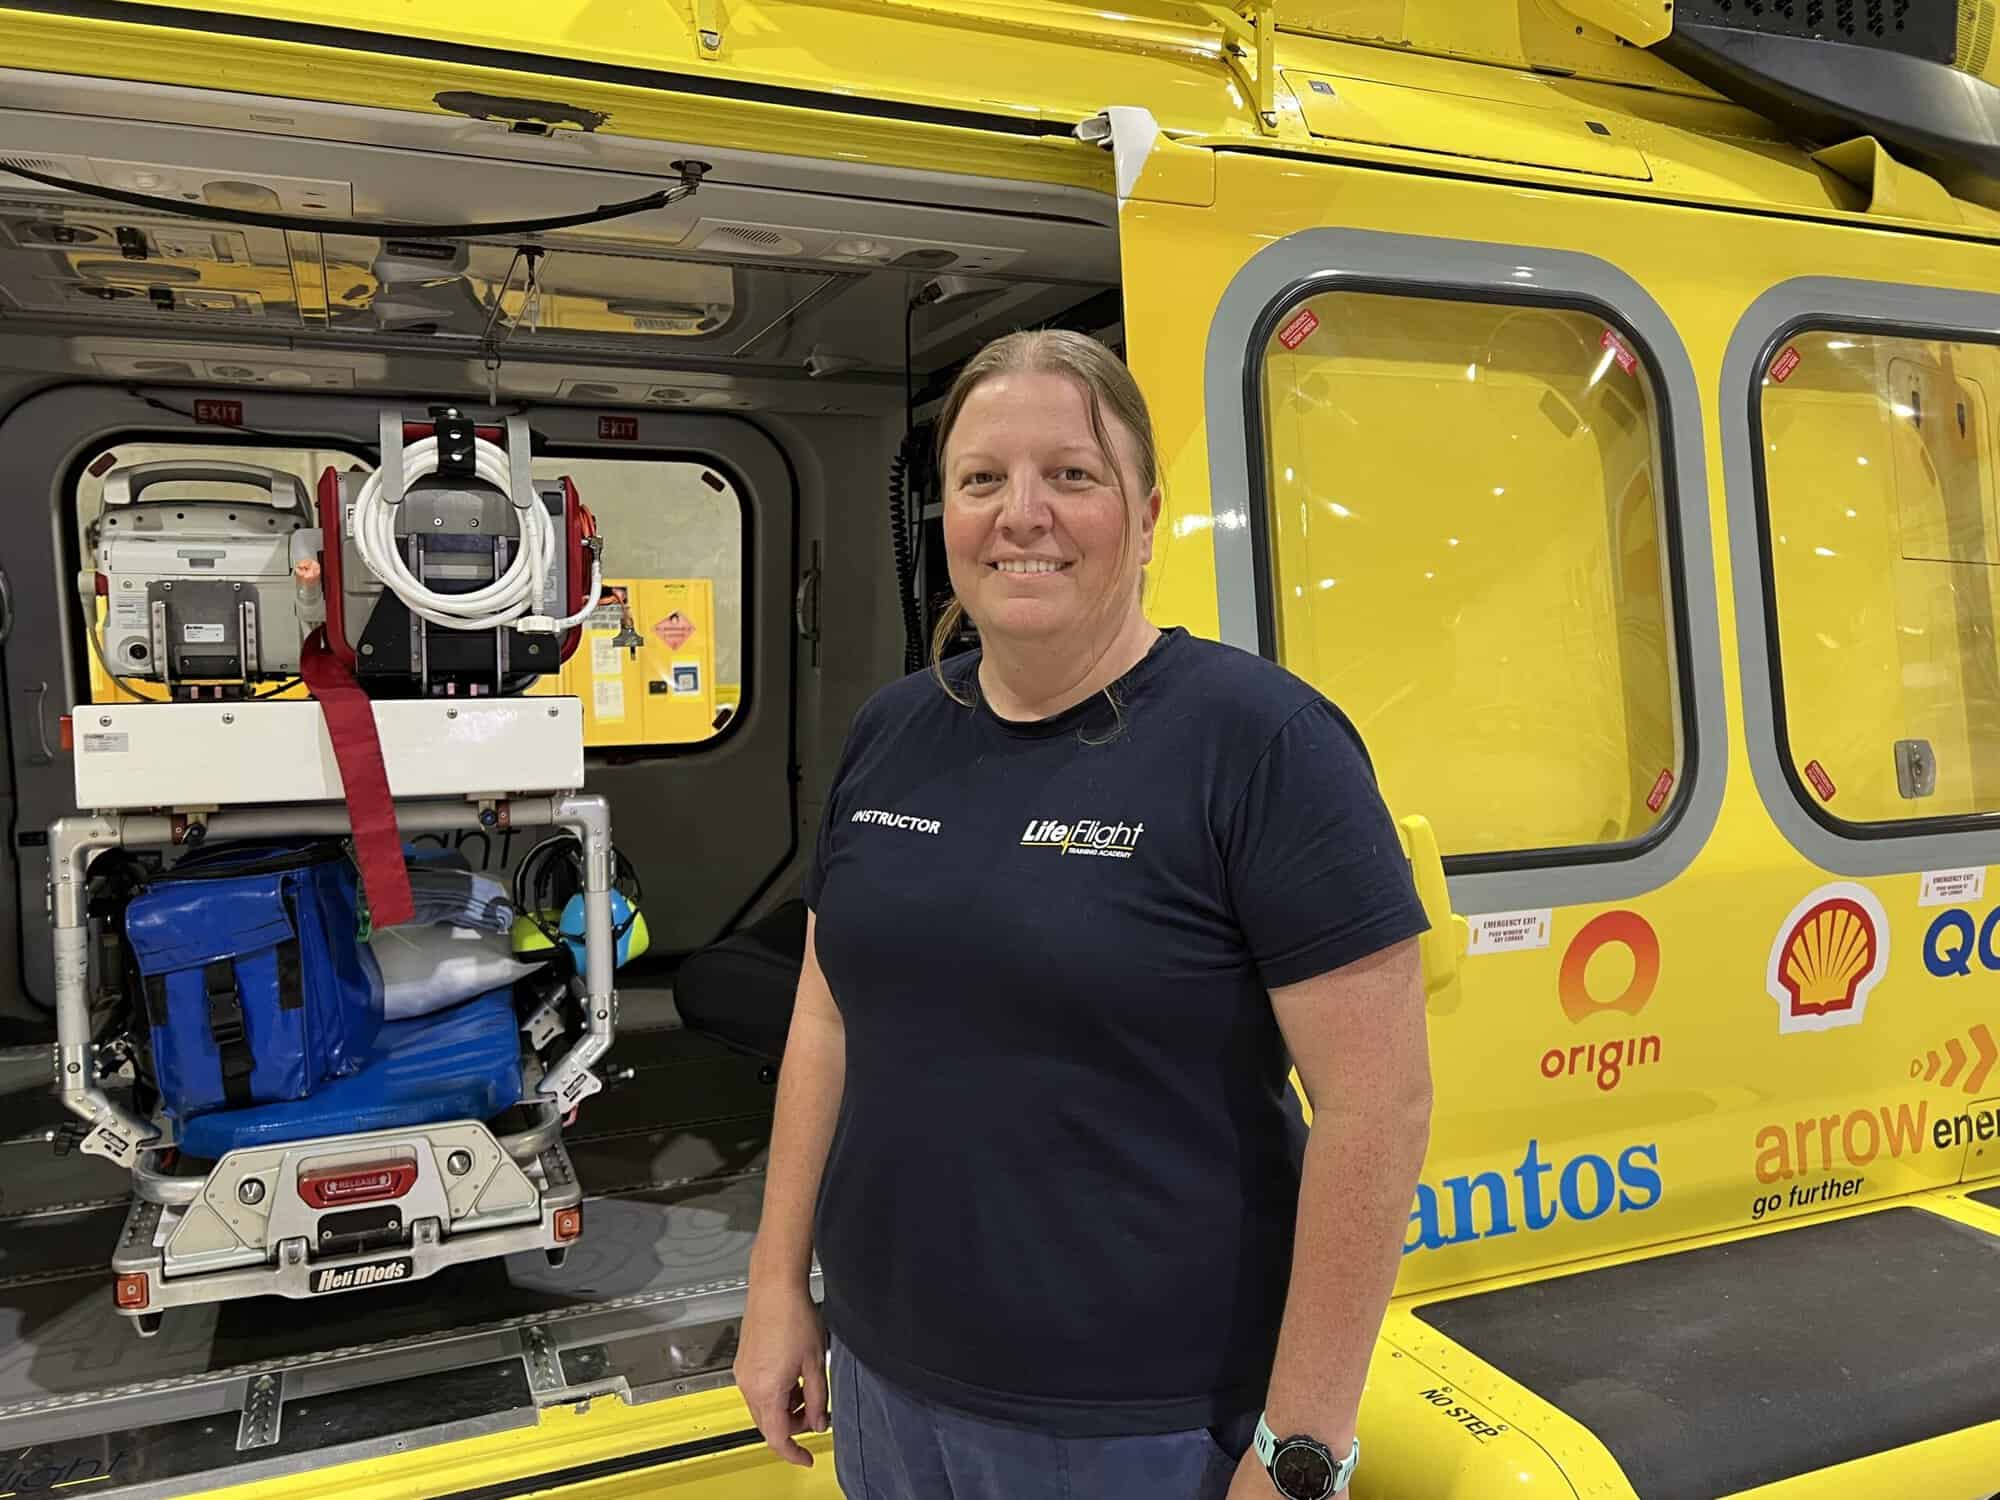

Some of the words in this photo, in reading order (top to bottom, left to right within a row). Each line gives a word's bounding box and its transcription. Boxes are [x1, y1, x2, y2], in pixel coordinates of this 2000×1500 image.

[198, 406, 239, 420] EXIT
[601, 420, 634, 436] EXIT
[851, 810, 940, 834] INSTRUCTOR
[1483, 918, 1522, 928] EMERGENCY
[1541, 1035, 1661, 1091] origin
[1755, 1100, 1928, 1184] arrow
[1402, 1139, 1662, 1255] antos
[1752, 1194, 1781, 1220] go
[1789, 1177, 1864, 1207] further
[1418, 1389, 1453, 1406] NO
[1445, 1408, 1498, 1436] STEP
